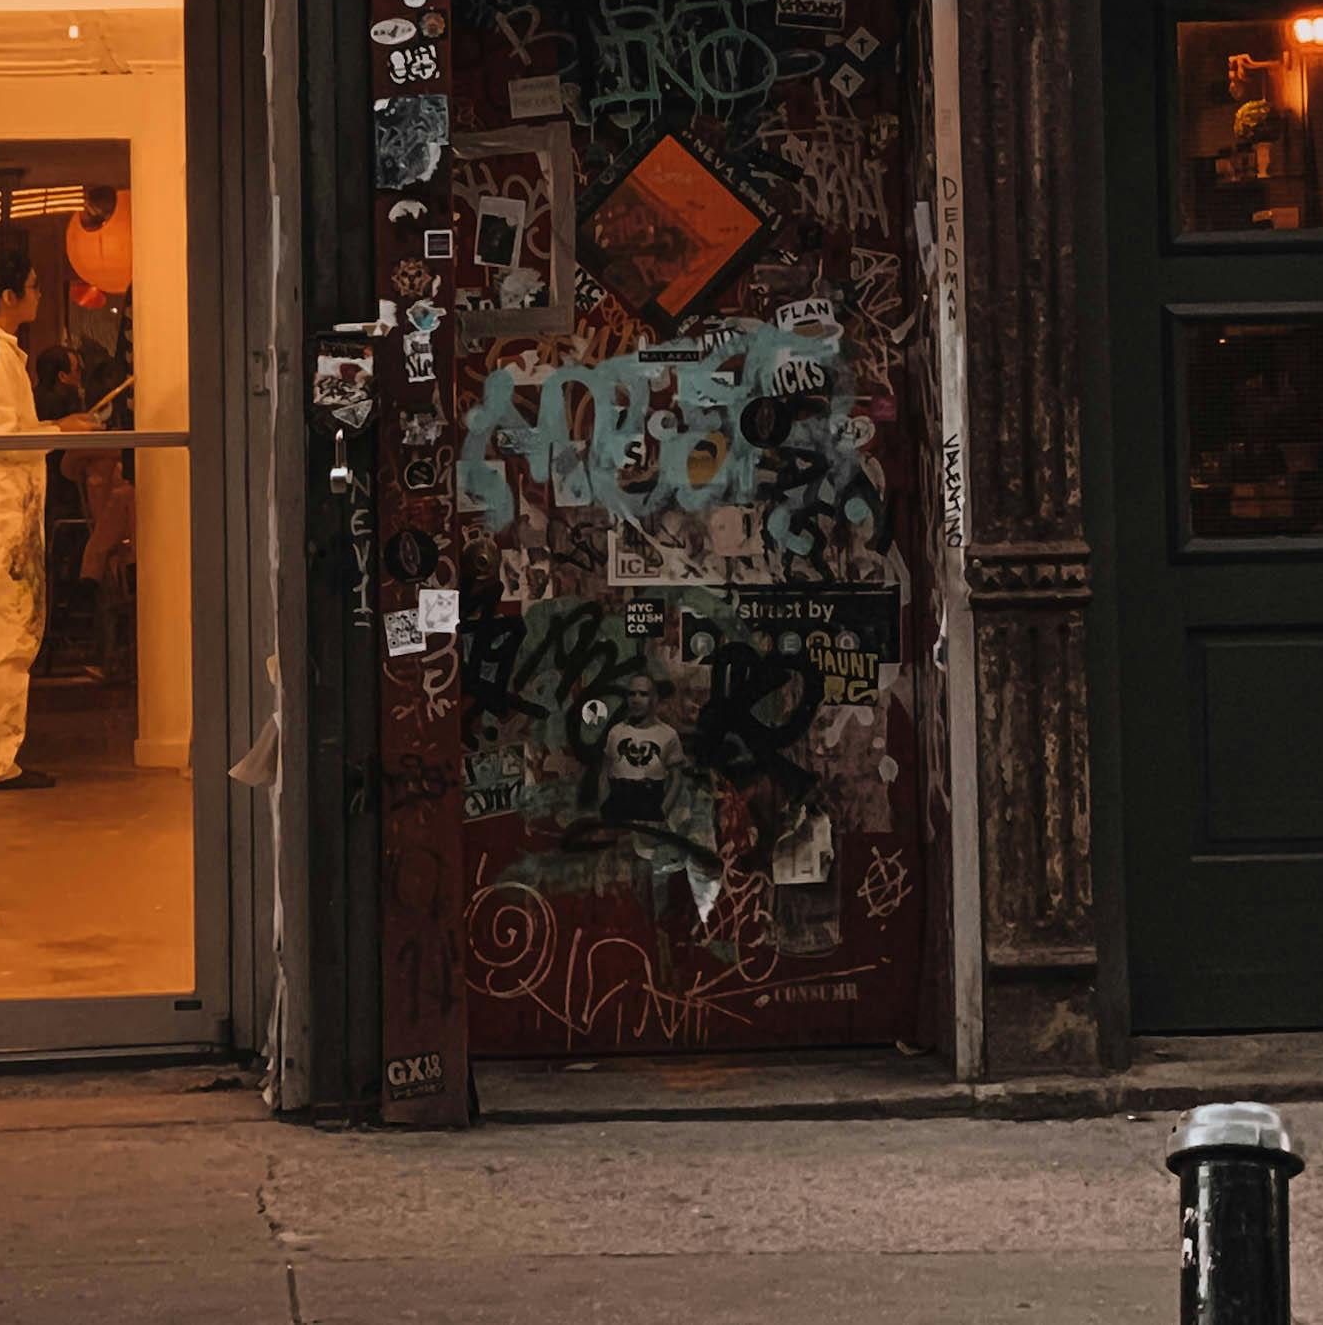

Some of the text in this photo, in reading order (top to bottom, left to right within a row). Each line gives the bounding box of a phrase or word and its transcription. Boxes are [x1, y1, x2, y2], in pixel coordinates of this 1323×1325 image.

[779, 302, 830, 323] FLAN
[942, 433, 962, 549] VALENTINO
[627, 603, 654, 613] NYC
[808, 600, 835, 624] by
[627, 613, 663, 623] KUSH
[627, 624, 649, 635] CO.
